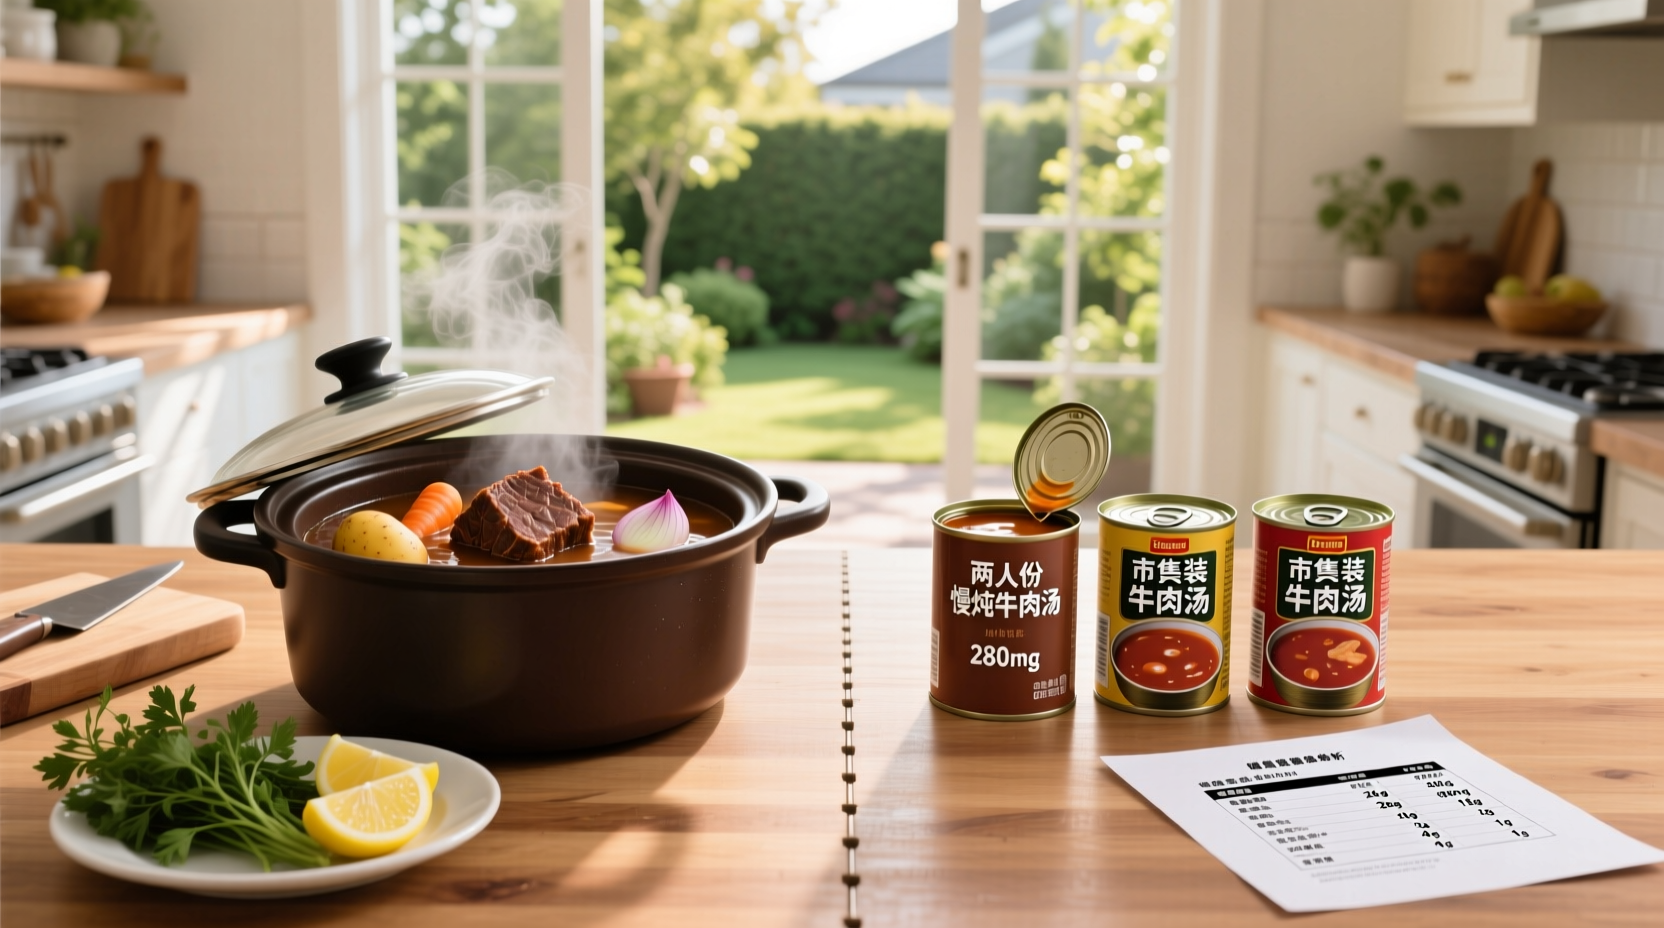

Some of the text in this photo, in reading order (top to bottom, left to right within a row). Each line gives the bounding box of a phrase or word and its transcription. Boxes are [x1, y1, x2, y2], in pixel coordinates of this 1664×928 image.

[970, 560, 1043, 588] 两人份
[950, 584, 1061, 618] 慢炖牛肉汤
[1128, 584, 1210, 615] 牛肉汤
[1284, 583, 1367, 614] 牛肉汤
[970, 643, 1040, 672] 280mg
